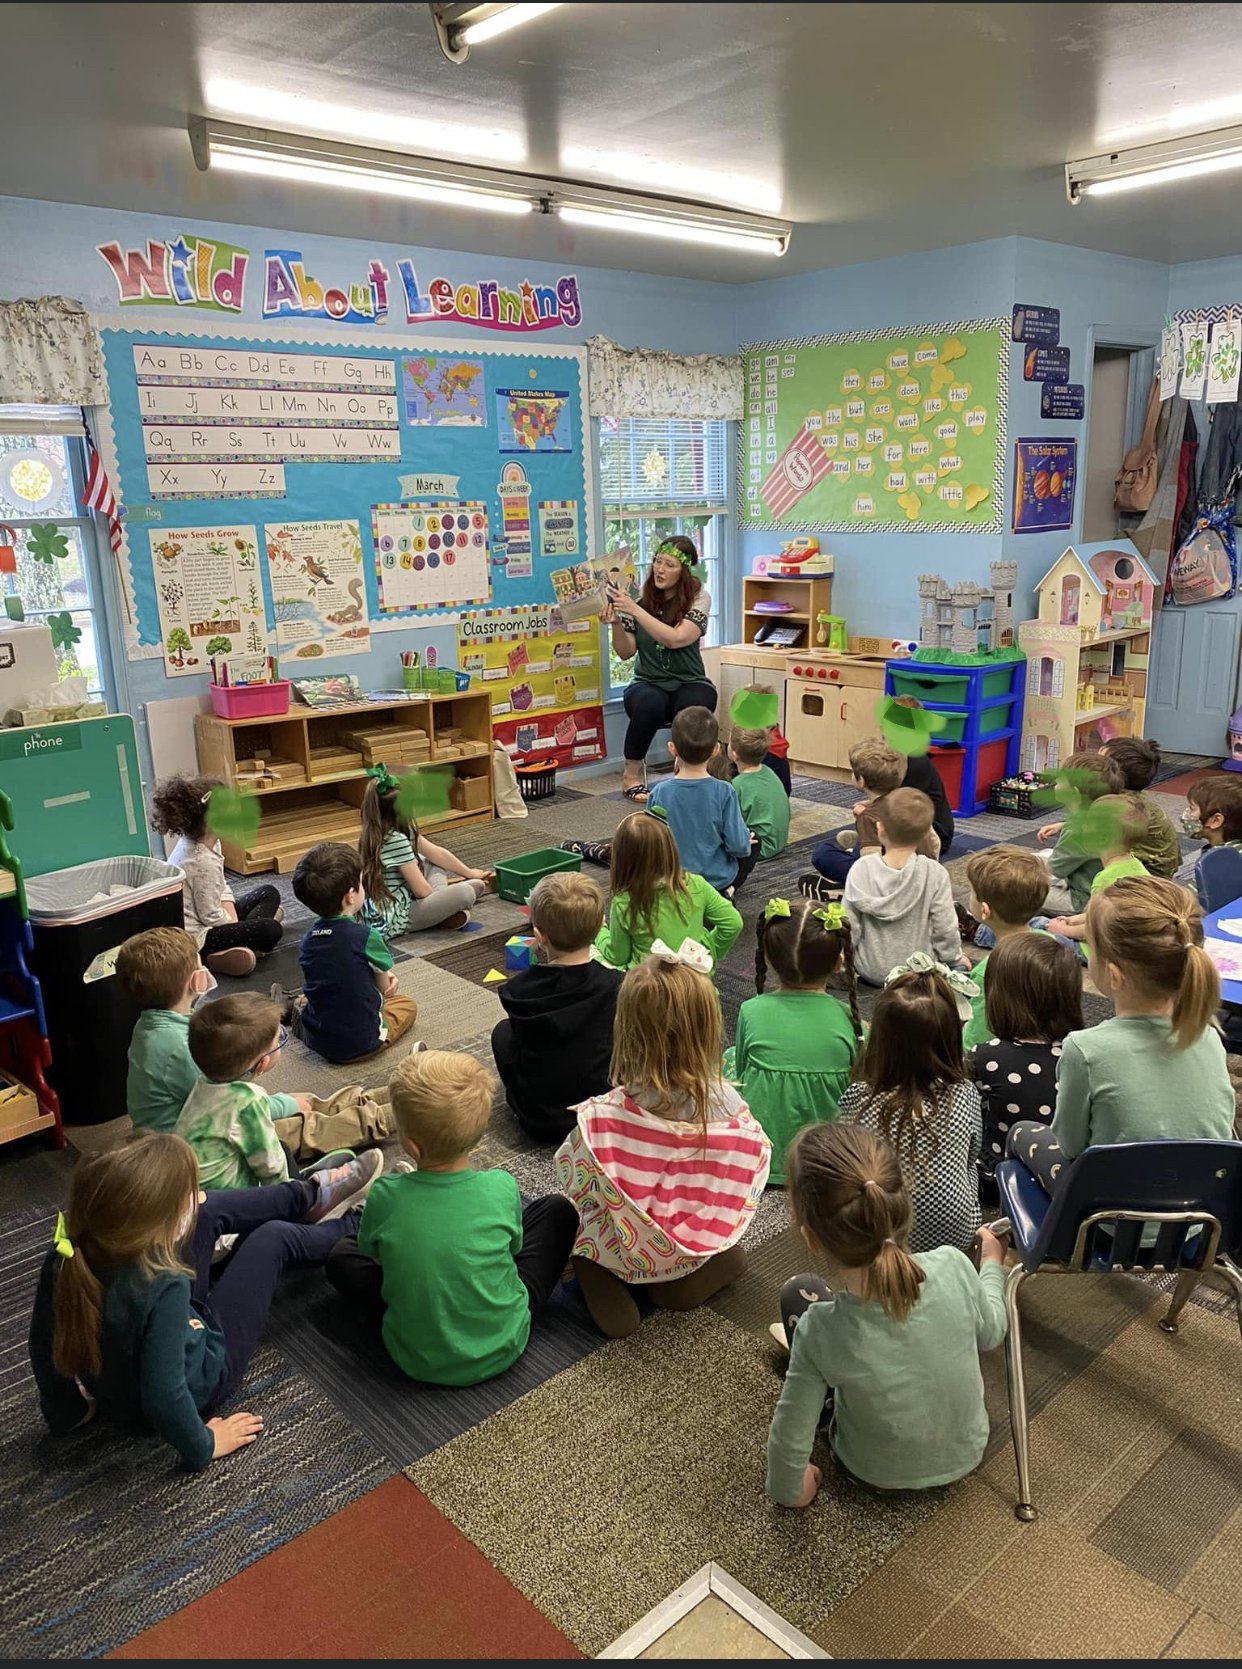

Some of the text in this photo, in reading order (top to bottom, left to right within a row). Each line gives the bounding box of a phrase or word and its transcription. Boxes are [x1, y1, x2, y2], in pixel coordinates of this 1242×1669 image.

[96, 237, 583, 327] Wild About Learning
[917, 351, 937, 360] come
[141, 352, 391, 382] Aa Bb Cc Dd Ee Ff Gg Hh
[892, 358, 908, 367] have
[872, 378, 883, 387] too
[901, 387, 918, 396] does
[951, 389, 967, 399] this
[146, 392, 394, 419] Ii Jj Kk Ll Mm Nn Oo Pp
[766, 403, 776, 413] all
[849, 405, 862, 414] but
[875, 404, 889, 413] are
[926, 402, 940, 410] like
[827, 412, 840, 423] the
[899, 416, 916, 425] want
[968, 414, 985, 423] play
[806, 419, 821, 429] you
[940, 426, 956, 437] good
[150, 432, 392, 452] Qq Rr Ss Tt Uu Vv Ww
[823, 437, 837, 445] was
[846, 436, 857, 446] his
[888, 448, 901, 459] for
[911, 444, 928, 454] here
[1028, 446, 1039, 456] The
[834, 463, 849, 472] and
[857, 459, 870, 470] her
[941, 459, 960, 468] what
[160, 469, 275, 488] Xx Yy Zz
[890, 476, 904, 486] had
[918, 474, 936, 483] with
[416, 478, 444, 491] March
[942, 489, 962, 499] little
[857, 501, 872, 511] him
[146, 507, 161, 520] flag
[301, 523, 321, 531] Seeds
[322, 522, 343, 530] Travel
[432, 520, 437, 528] 2
[475, 517, 481, 525] 5
[168, 530, 239, 540] How Seeds Grow
[402, 540, 407, 548] 7
[475, 535, 482, 544] 12
[386, 556, 394, 565] 13
[403, 555, 411, 565] 14
[446, 553, 452, 561] 17
[463, 621, 524, 636] Classroom
[526, 616, 548, 630] Jobs
[24, 735, 63, 757] phone
